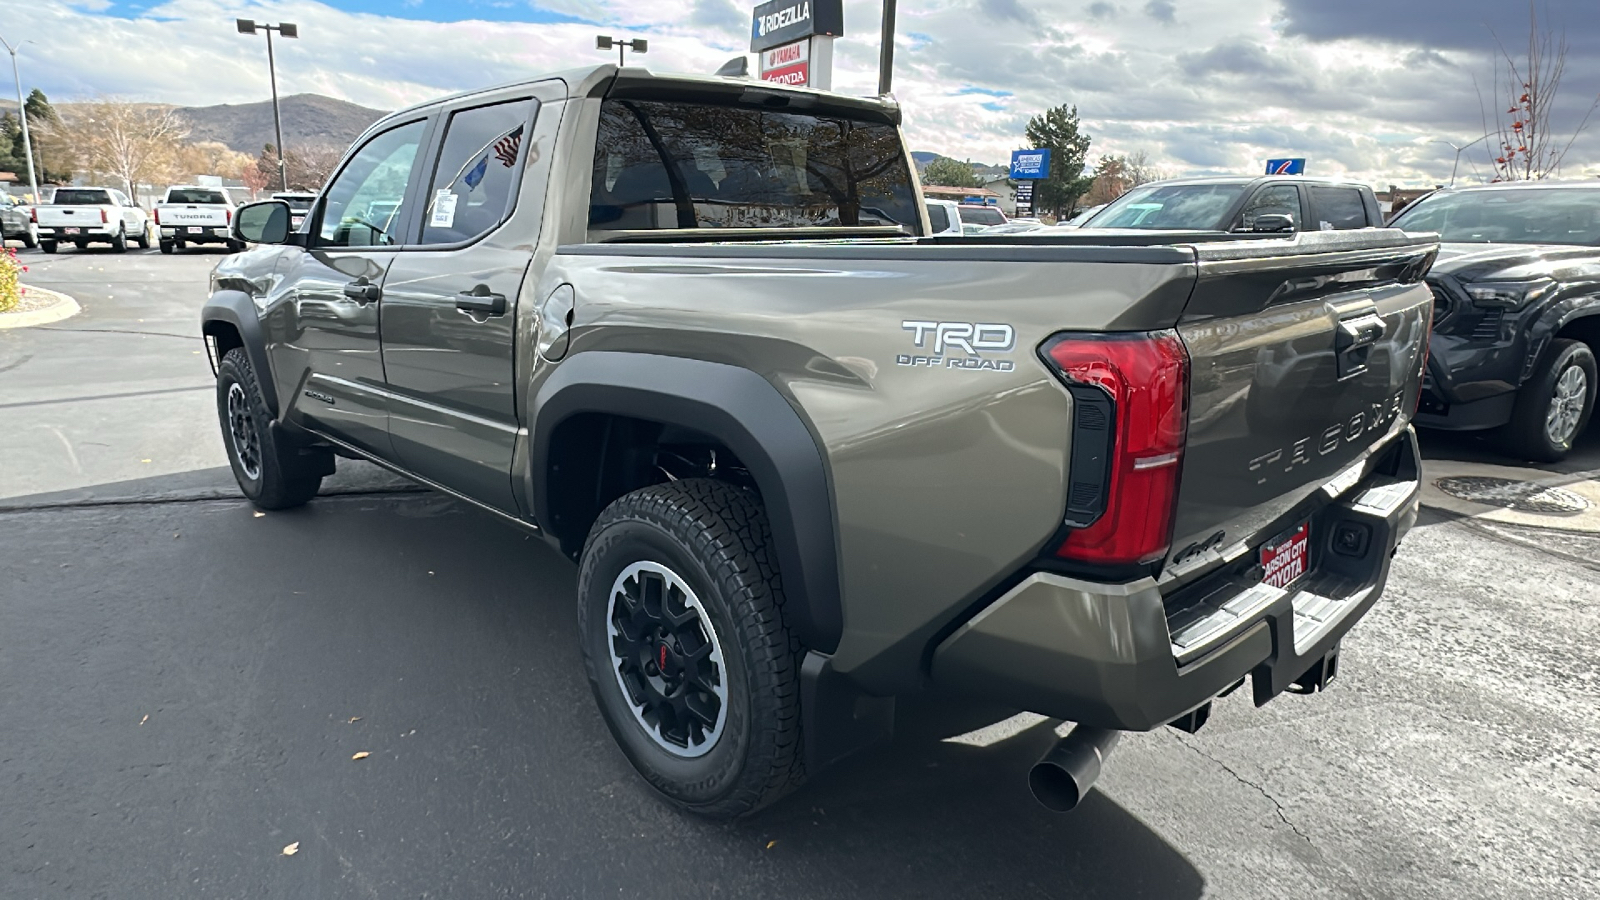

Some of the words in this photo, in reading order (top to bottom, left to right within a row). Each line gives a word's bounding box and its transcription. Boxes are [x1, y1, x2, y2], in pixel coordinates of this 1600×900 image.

[766, 1, 810, 33] RIDEZILLA
[776, 44, 801, 66] YAMAHA
[902, 320, 1016, 357] TRD
[896, 354, 942, 367] OFF
[946, 357, 1016, 372] ROAD
[1292, 537, 1308, 558] CITY
